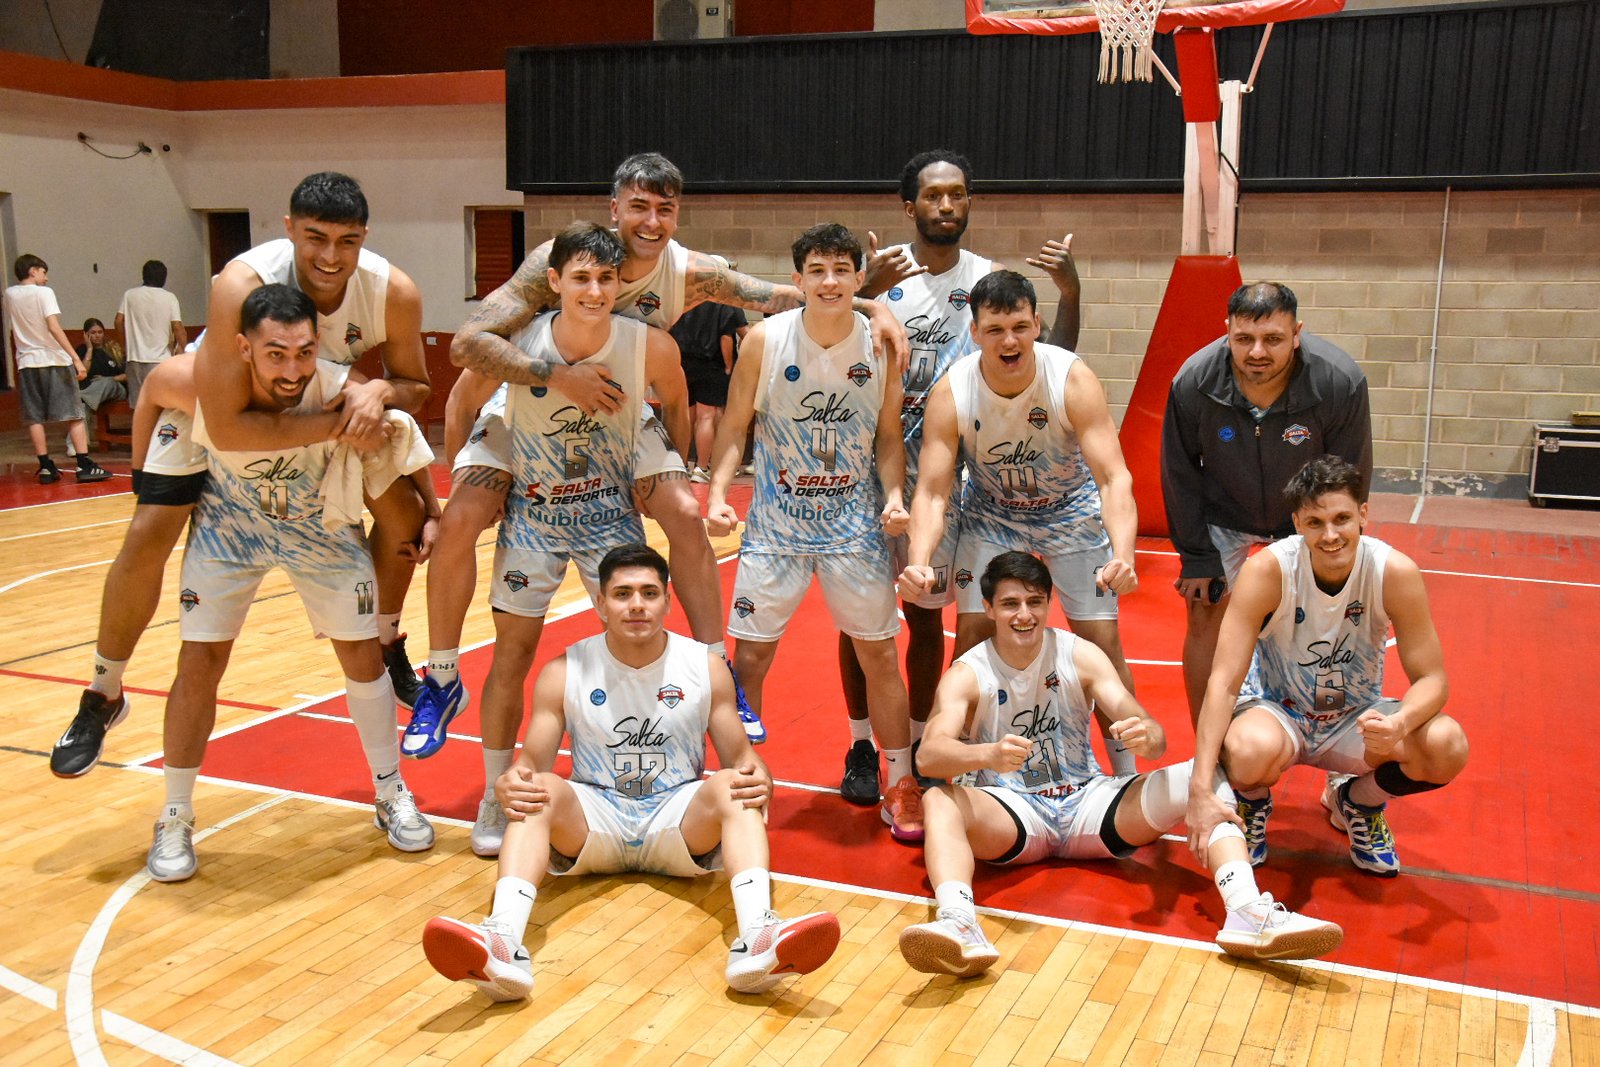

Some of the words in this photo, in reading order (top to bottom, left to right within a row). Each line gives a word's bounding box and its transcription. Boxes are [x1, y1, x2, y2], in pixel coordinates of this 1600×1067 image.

[905, 315, 956, 345] Salta
[542, 406, 607, 436] Salta
[792, 391, 860, 424] Salta
[565, 437, 590, 480] 5
[811, 428, 836, 472] 4
[983, 436, 1045, 465] Salta
[550, 478, 602, 495] SALTA
[550, 486, 619, 505] DEPORTES
[796, 474, 850, 487] SALTA
[996, 466, 1039, 499] 14
[255, 484, 288, 517] 11
[528, 507, 621, 527] Nubicom
[355, 581, 374, 615] 11
[1298, 633, 1355, 669] Salta
[605, 716, 673, 748] Salta
[614, 752, 666, 797] 27
